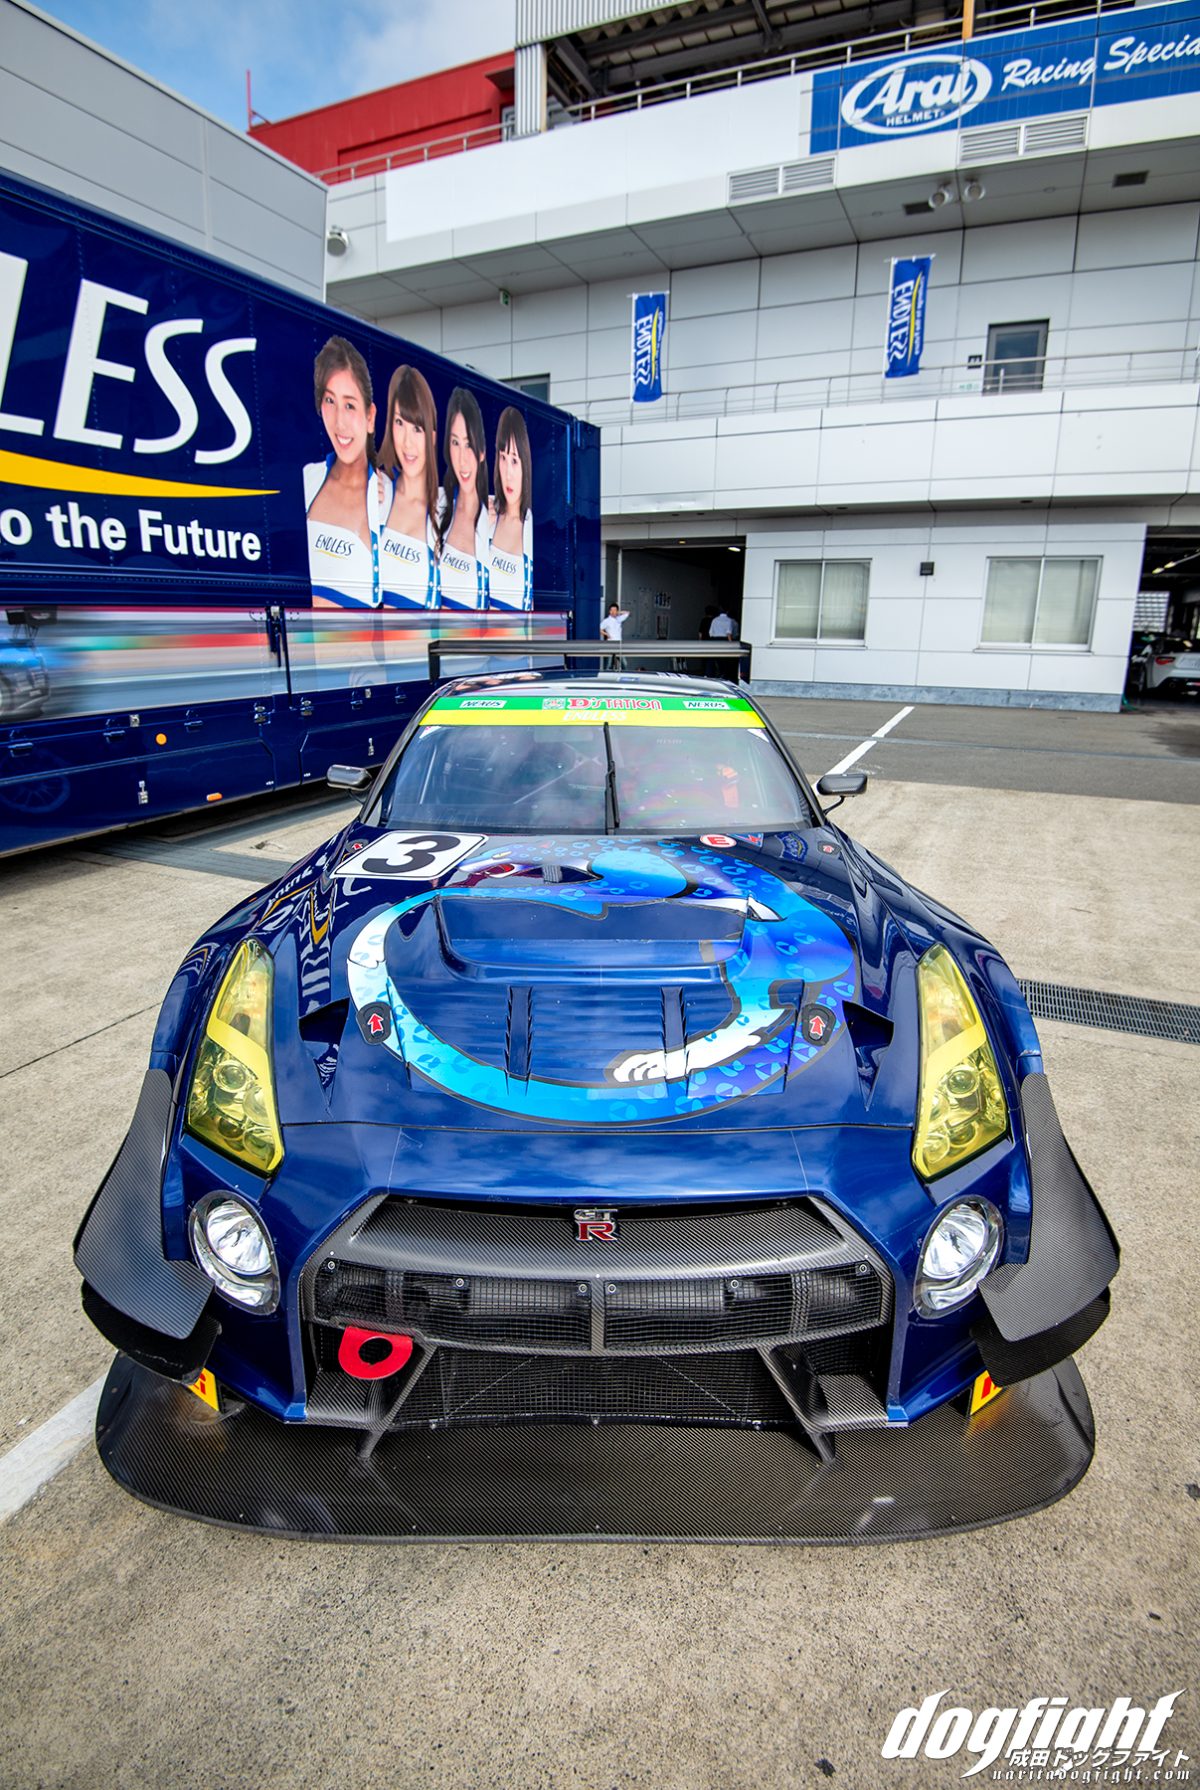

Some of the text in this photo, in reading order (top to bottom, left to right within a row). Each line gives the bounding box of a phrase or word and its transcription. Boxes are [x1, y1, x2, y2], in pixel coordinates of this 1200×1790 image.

[1001, 34, 1200, 92] Racing Specia
[850, 68, 974, 116] Arai
[886, 109, 942, 127] HELMET
[0, 501, 261, 561] o the Future
[315, 534, 355, 556] ENDLESS
[383, 539, 421, 563] ENDLESS
[442, 553, 470, 572] ENDLESS
[492, 557, 517, 574] ENDLESS
[563, 711, 627, 721] ENDLESS
[706, 836, 731, 846] E
[362, 835, 461, 874] 3
